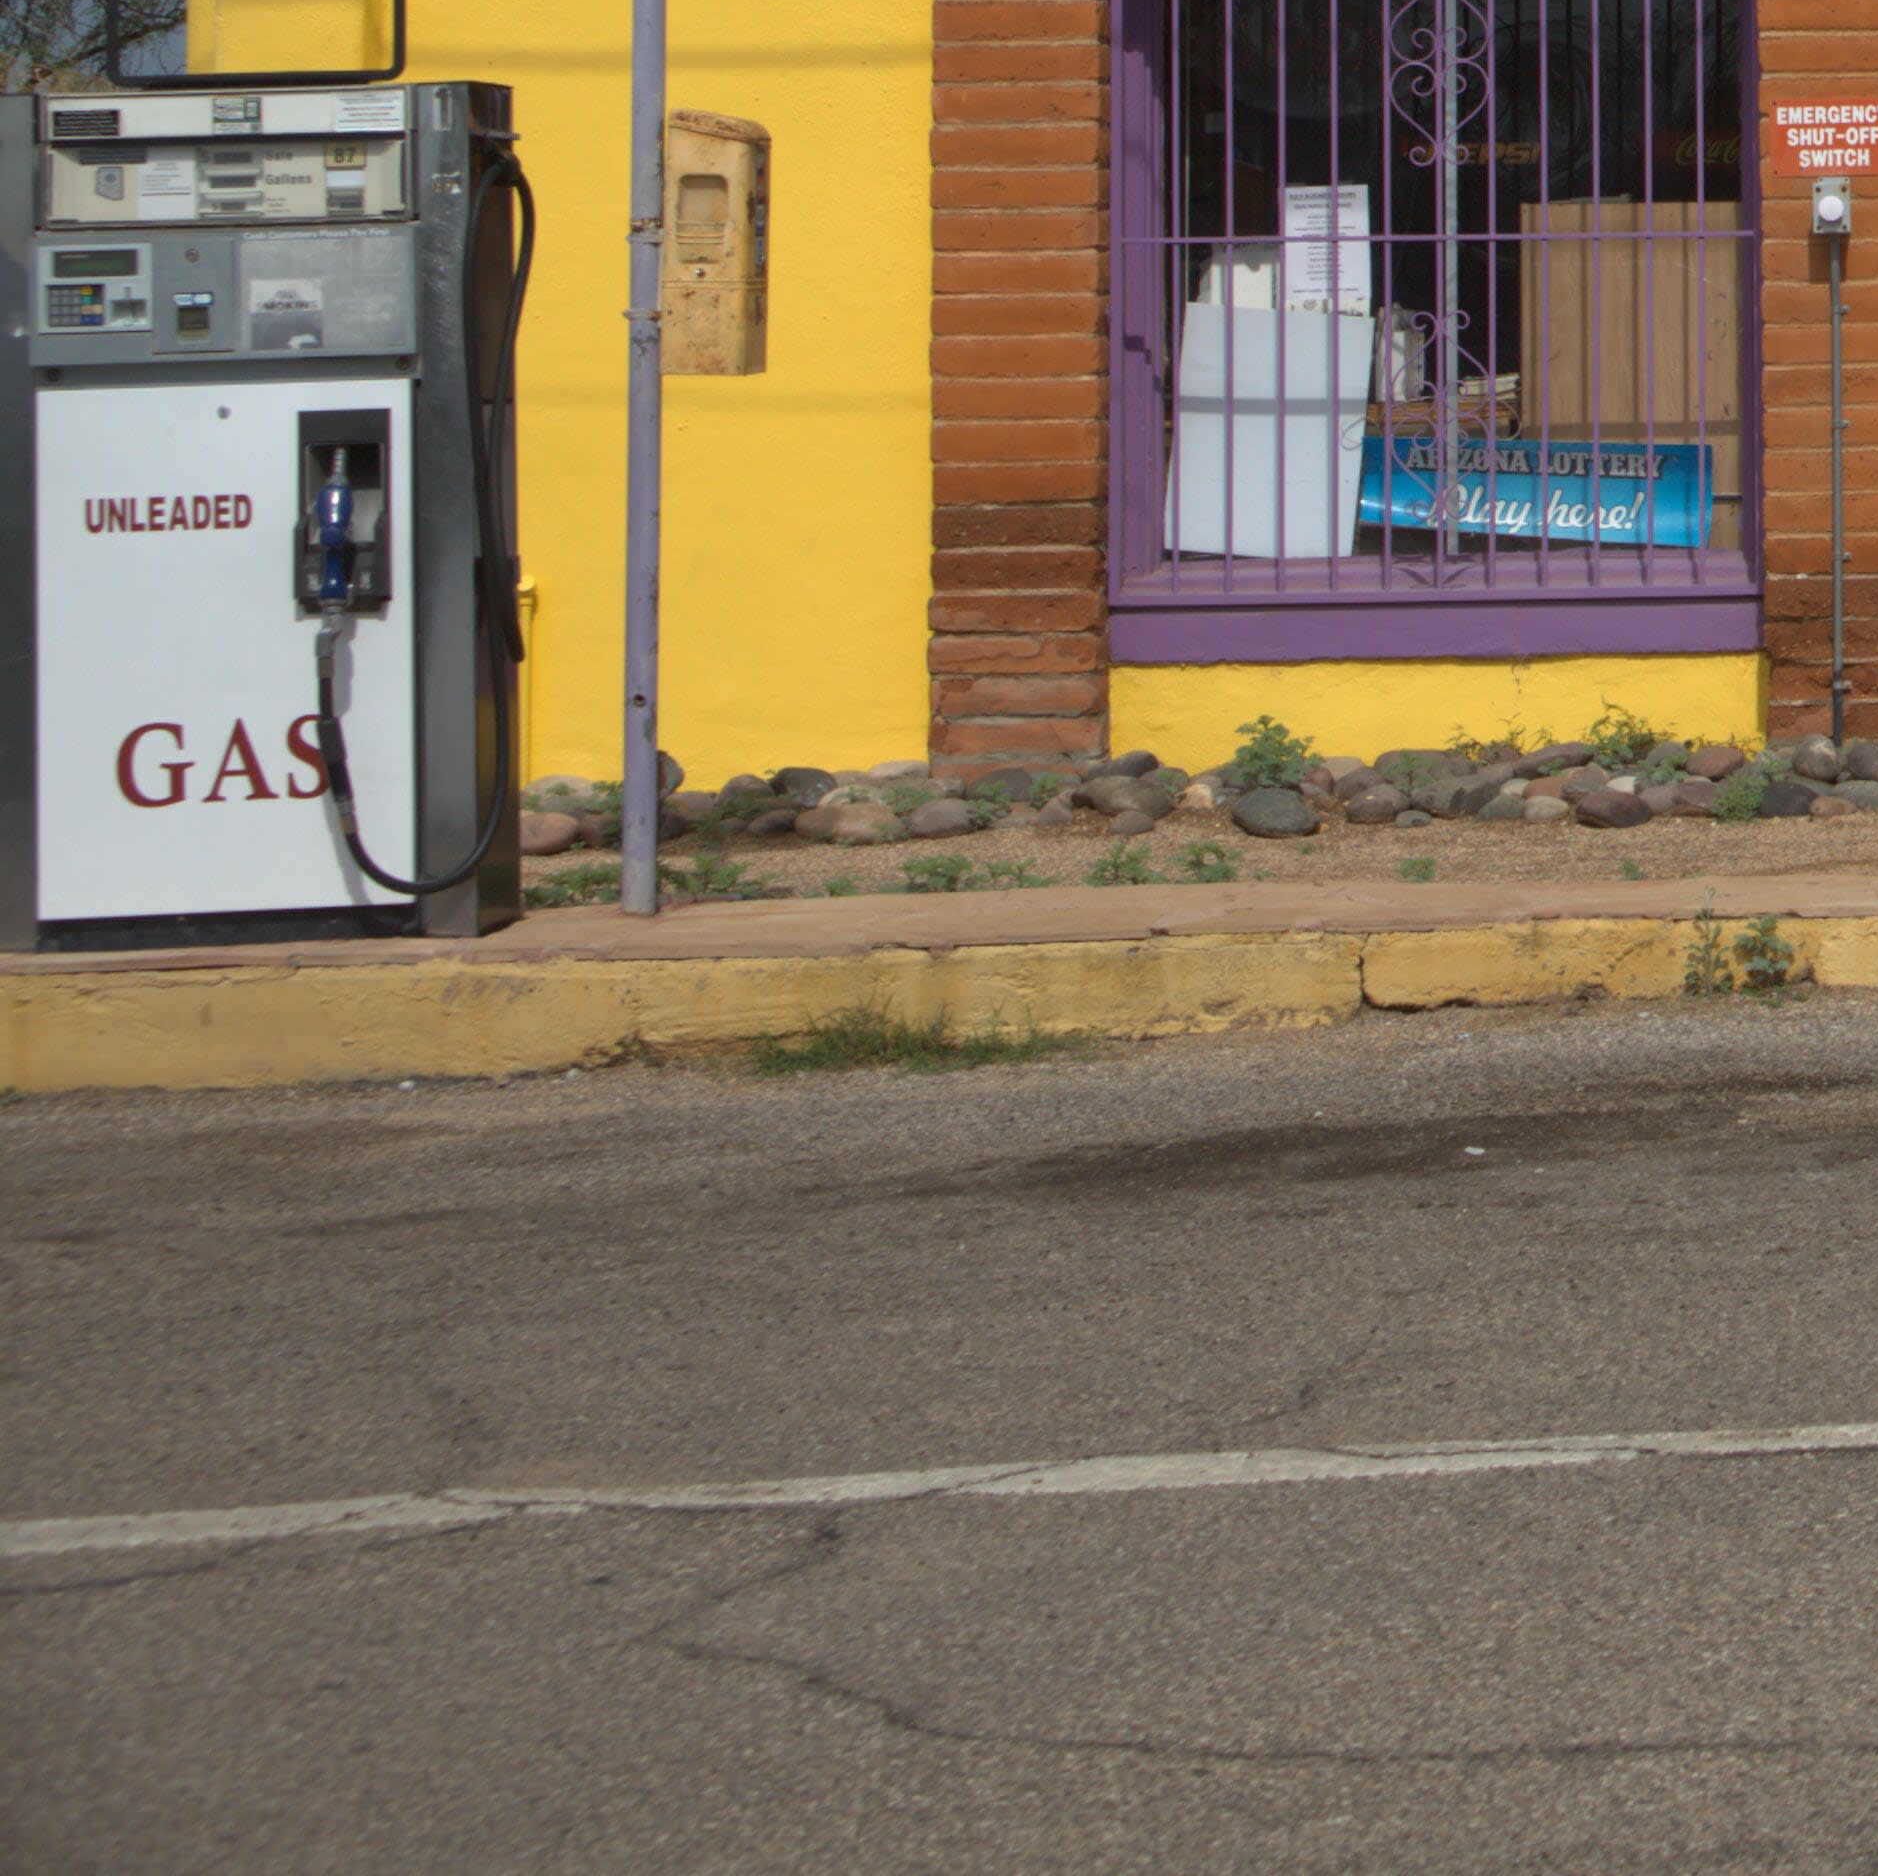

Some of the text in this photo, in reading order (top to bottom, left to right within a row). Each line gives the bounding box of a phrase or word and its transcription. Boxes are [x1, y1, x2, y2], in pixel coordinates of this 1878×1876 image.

[334, 148, 355, 163] 87
[1799, 149, 1870, 167] SWITCH
[265, 173, 312, 185] Gallons
[1406, 447, 1530, 473] ARZONA
[84, 493, 253, 535] UNLEADED
[1536, 489, 1645, 530] here!
[115, 714, 333, 809] GAS
